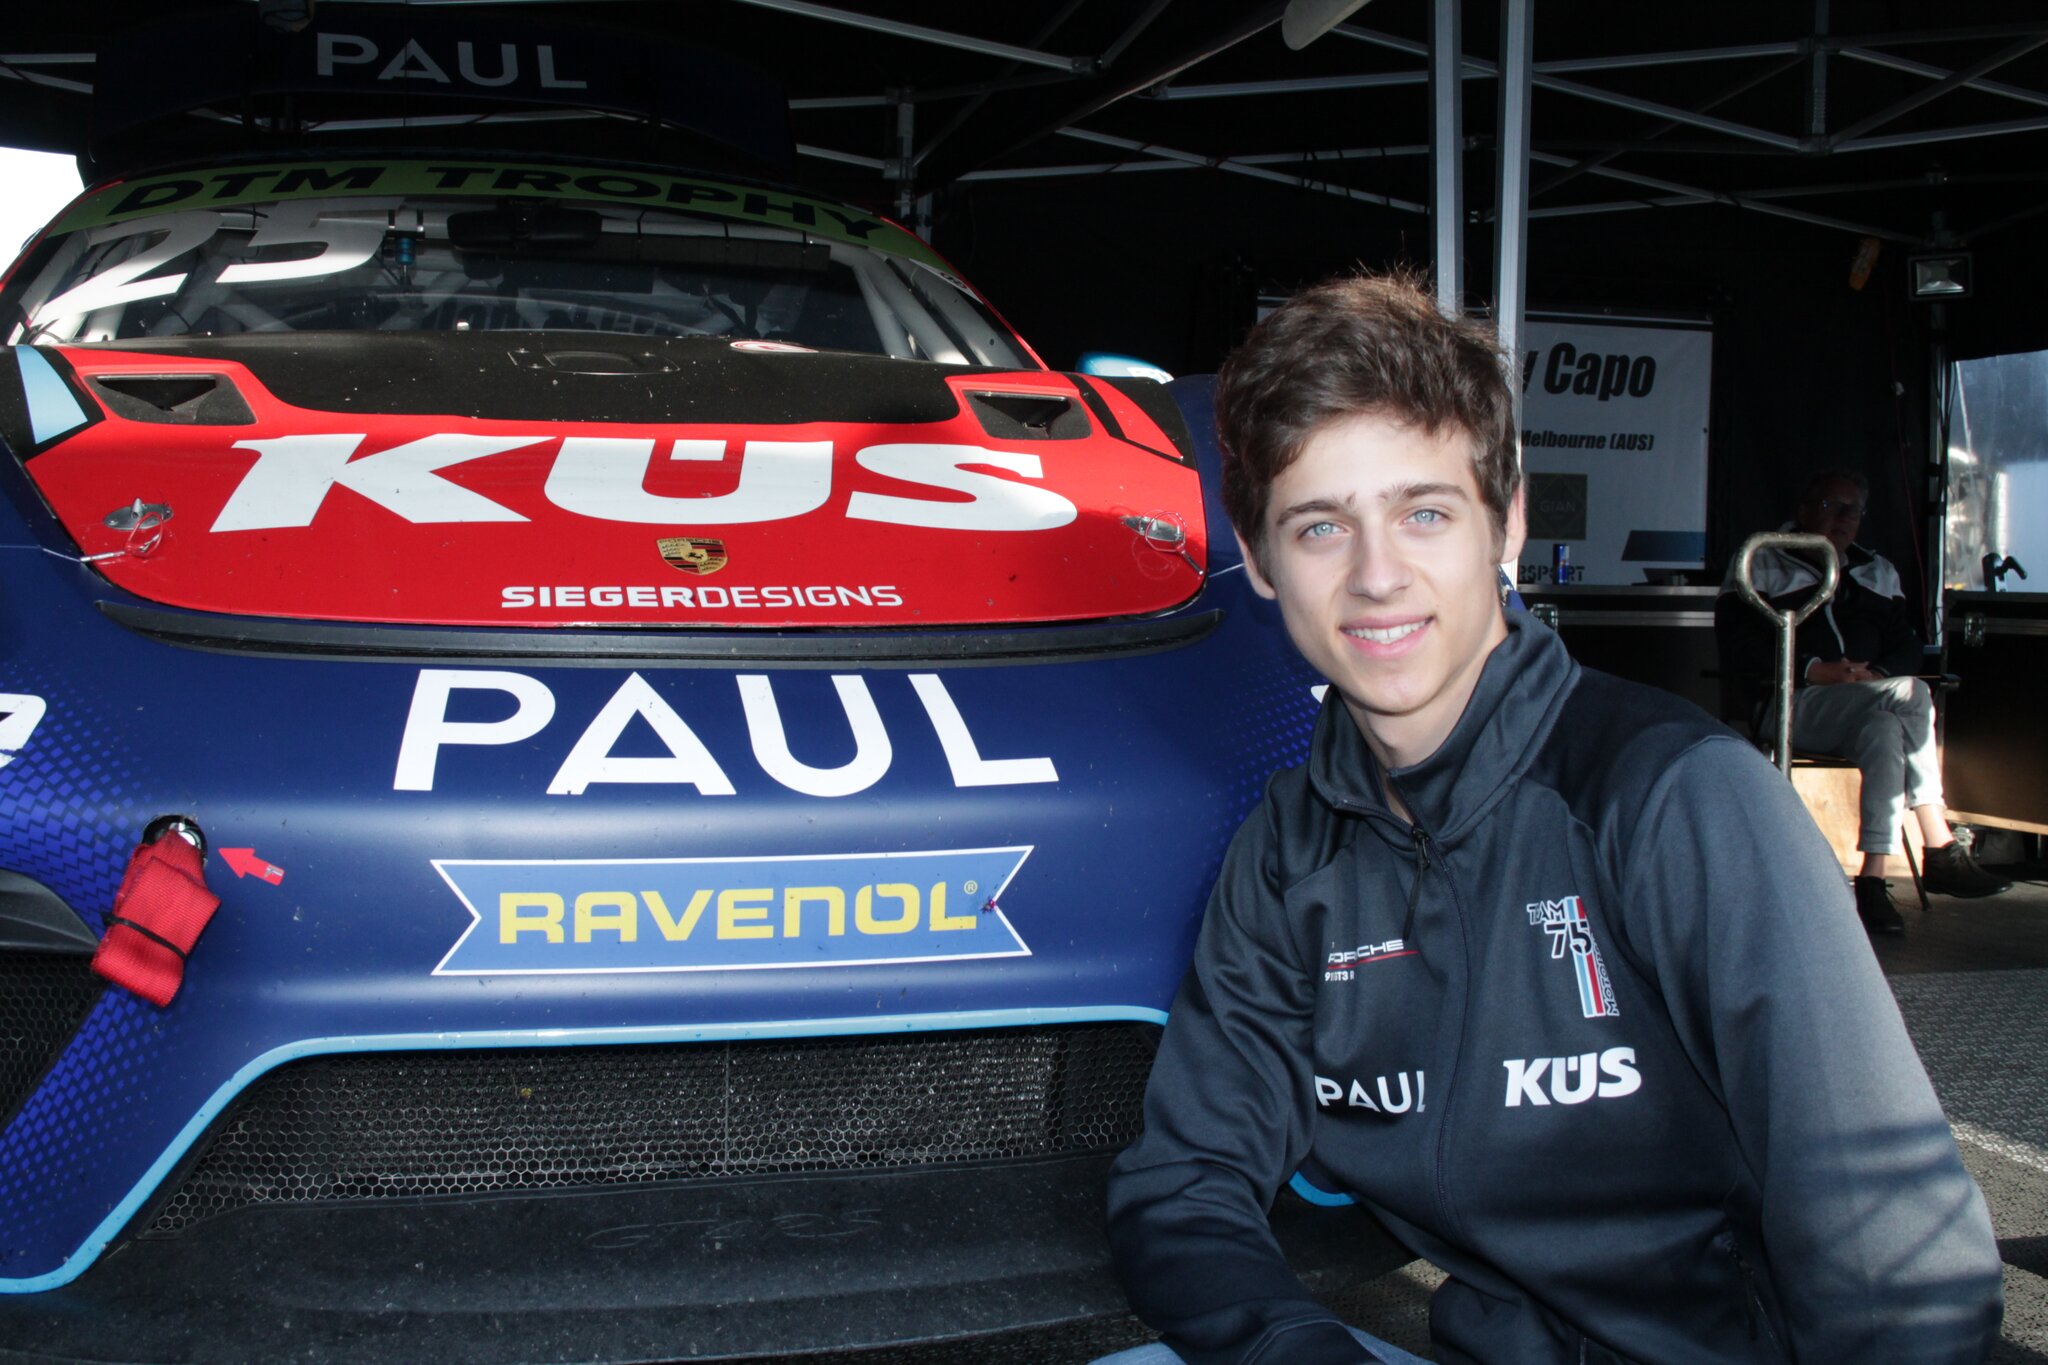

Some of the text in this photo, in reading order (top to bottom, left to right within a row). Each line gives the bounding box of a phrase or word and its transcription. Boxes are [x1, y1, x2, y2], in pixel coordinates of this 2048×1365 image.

[316, 32, 588, 90] PAUL
[108, 166, 887, 240] DTM TROPHY
[30, 196, 405, 329] 25
[1544, 342, 1656, 401] Capo
[1521, 429, 1654, 452] Melbourne (AUS)
[209, 433, 1078, 533] KÜS
[1539, 499, 1577, 513] GIAN
[501, 585, 904, 609] SIEGERDESIGNS
[392, 668, 1060, 797] PAUL
[1544, 920, 1593, 959] 75
[1313, 1070, 1426, 1114] PAUL
[1502, 1046, 1642, 1108] KÜS
